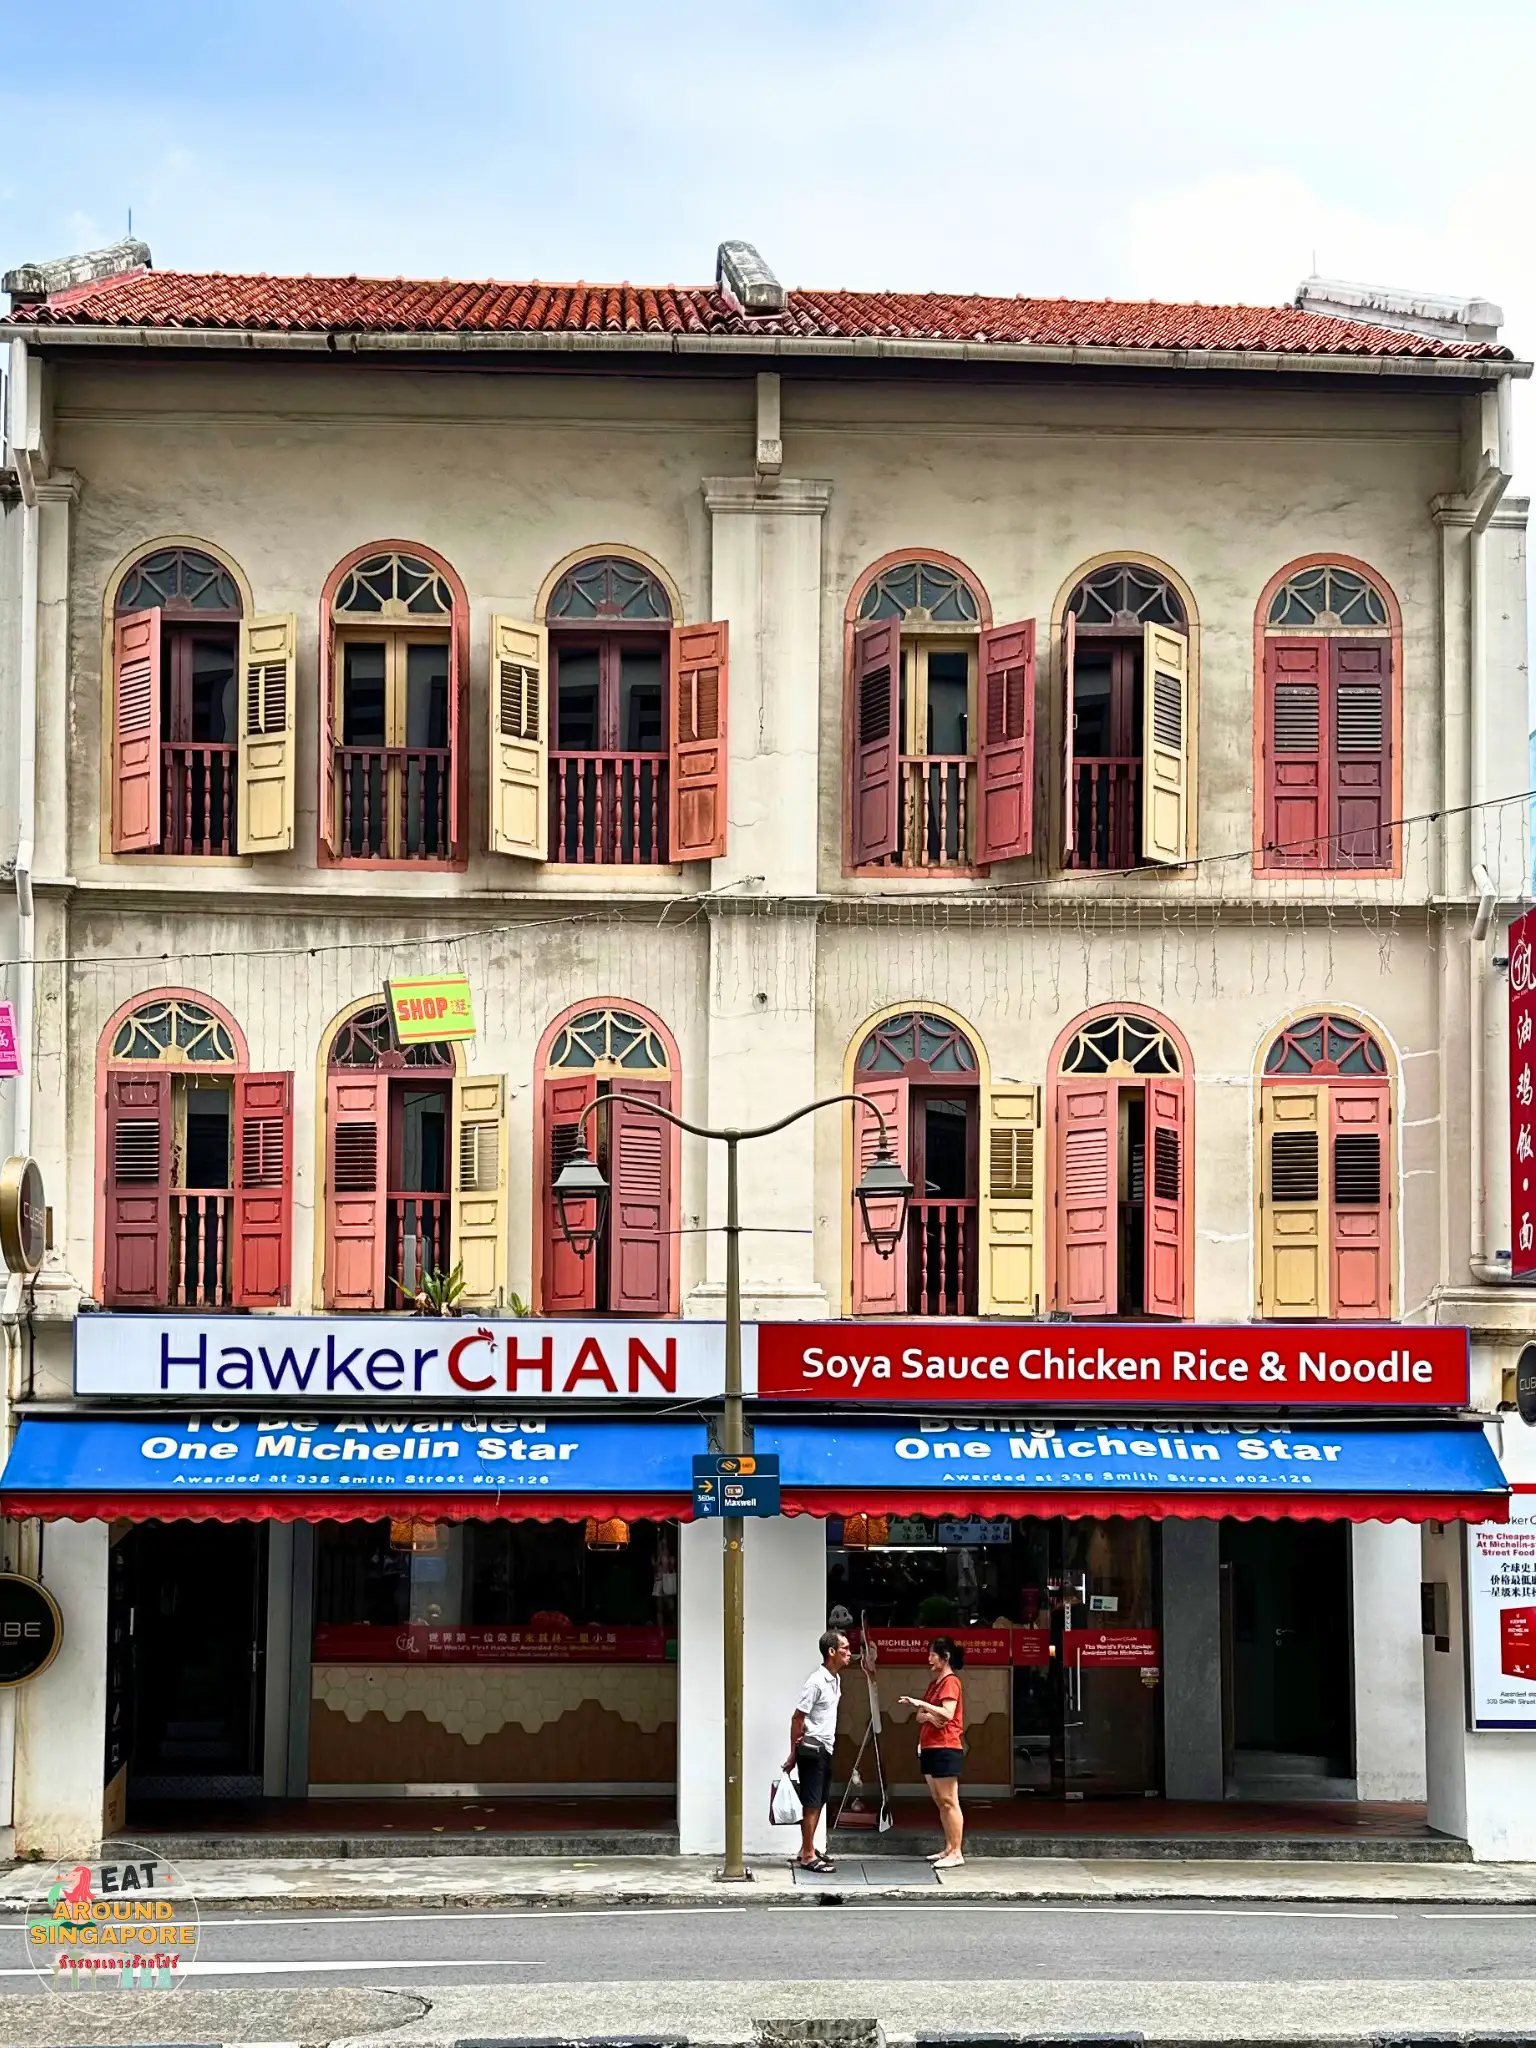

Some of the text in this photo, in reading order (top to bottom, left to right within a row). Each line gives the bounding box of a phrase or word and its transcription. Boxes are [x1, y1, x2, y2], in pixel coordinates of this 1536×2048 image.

[396, 997, 448, 1021] SHOP
[802, 1347, 1433, 1387] Soya Sauce Chicken Rice & Noodle
[141, 1435, 579, 1460] One Michelin Star
[895, 1436, 1342, 1462] One Michelin Star
[173, 1473, 260, 1484] Awarded
[269, 1474, 287, 1484] at
[339, 1475, 395, 1484] Smith
[405, 1474, 464, 1484] Street
[943, 1473, 1026, 1482] Awarded
[1103, 1472, 1159, 1482] Smith
[1167, 1474, 1228, 1483] Street
[724, 1498, 757, 1507] Maxwell
